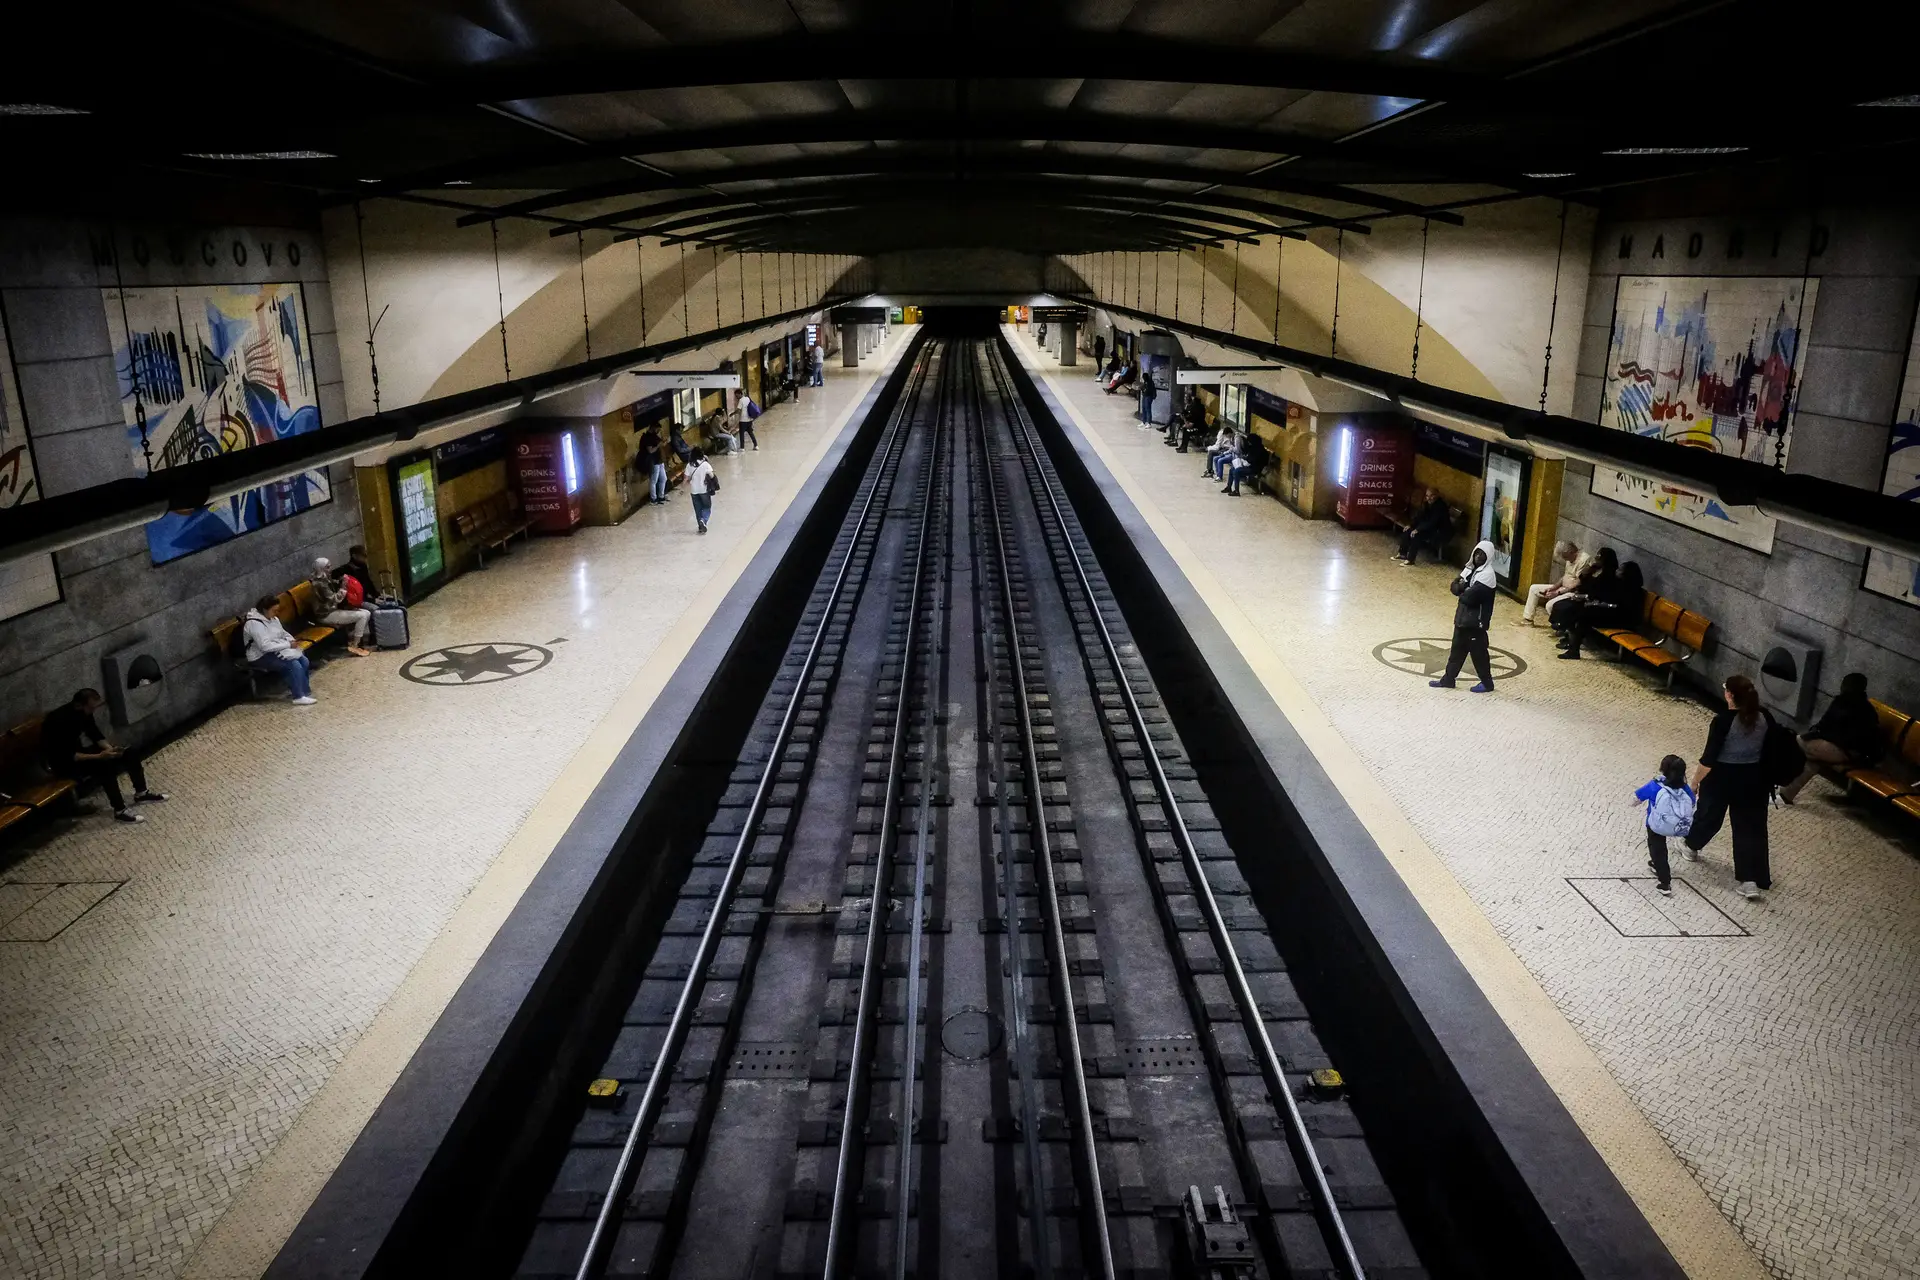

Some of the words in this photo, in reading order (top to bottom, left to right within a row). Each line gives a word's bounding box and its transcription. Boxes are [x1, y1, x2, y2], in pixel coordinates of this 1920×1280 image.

[1619, 225, 1829, 259] MADRID
[88, 228, 301, 267] MOSCOVO
[1360, 463, 1395, 472] DRINKS
[520, 468, 556, 477] DRINKS
[523, 485, 558, 494] SNACKS
[1358, 481, 1393, 489] SNACKS
[1357, 498, 1392, 506] BEBIDAS
